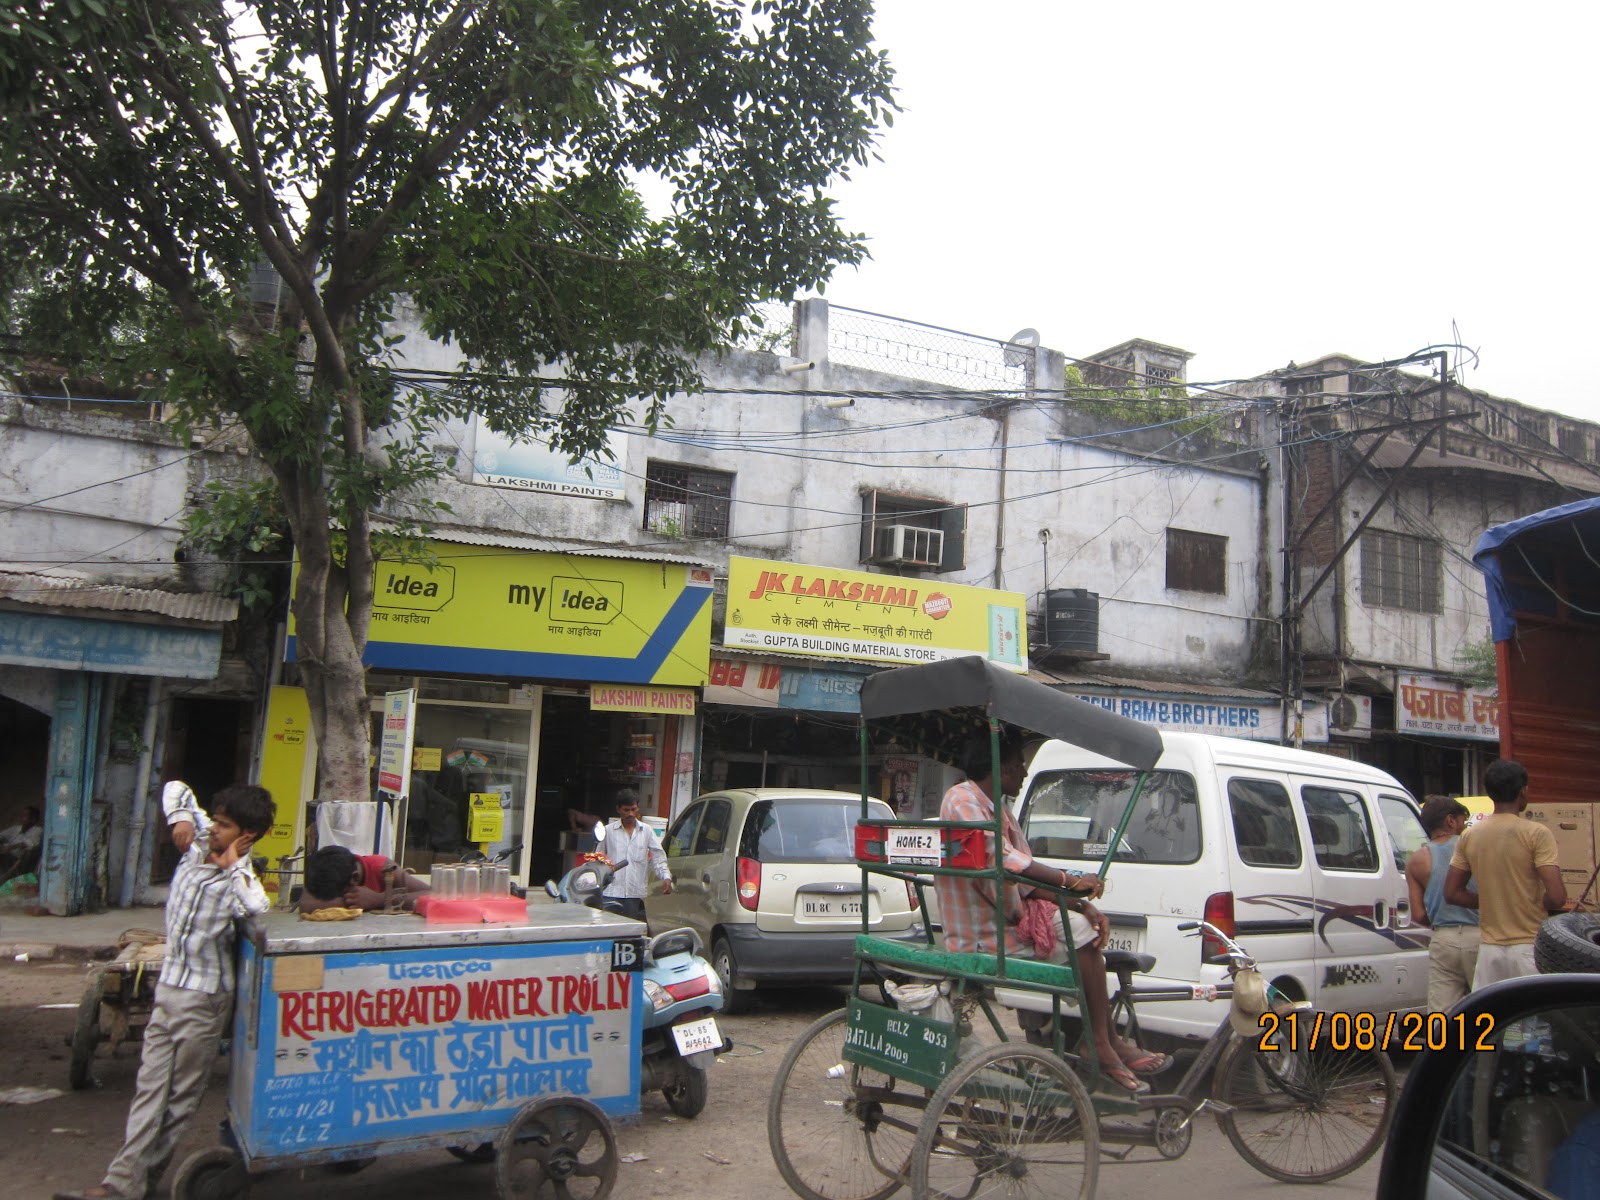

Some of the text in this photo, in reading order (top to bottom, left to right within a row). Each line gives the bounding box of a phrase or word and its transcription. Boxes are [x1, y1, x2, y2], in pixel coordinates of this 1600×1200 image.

[487, 475, 614, 497] LAKSHMI PAINTS
[508, 584, 546, 612] my
[749, 571, 918, 607] JK LAKSHMI
[765, 593, 918, 617] CEMENT
[392, 612, 430, 625] आइडिया
[548, 625, 601, 637] माय आइडिया
[795, 616, 818, 629] लक्ष्मी
[895, 627, 907, 638] की
[909, 628, 933, 641] गारंटी
[764, 635, 799, 648] GUPTA
[802, 638, 850, 652] BUILDING
[852, 643, 901, 658] MATERIAL
[904, 648, 936, 661] STORE
[593, 688, 693, 710] LAKSHMI PAINTS
[1400, 675, 1466, 723] पंजाब
[1172, 702, 1260, 728] BROTHERS
[896, 836, 932, 849] HOME-2
[806, 903, 817, 912] DL
[278, 972, 631, 1041] REFRIGERATED WATER TROLLY
[508, 1011, 594, 1060] पानी
